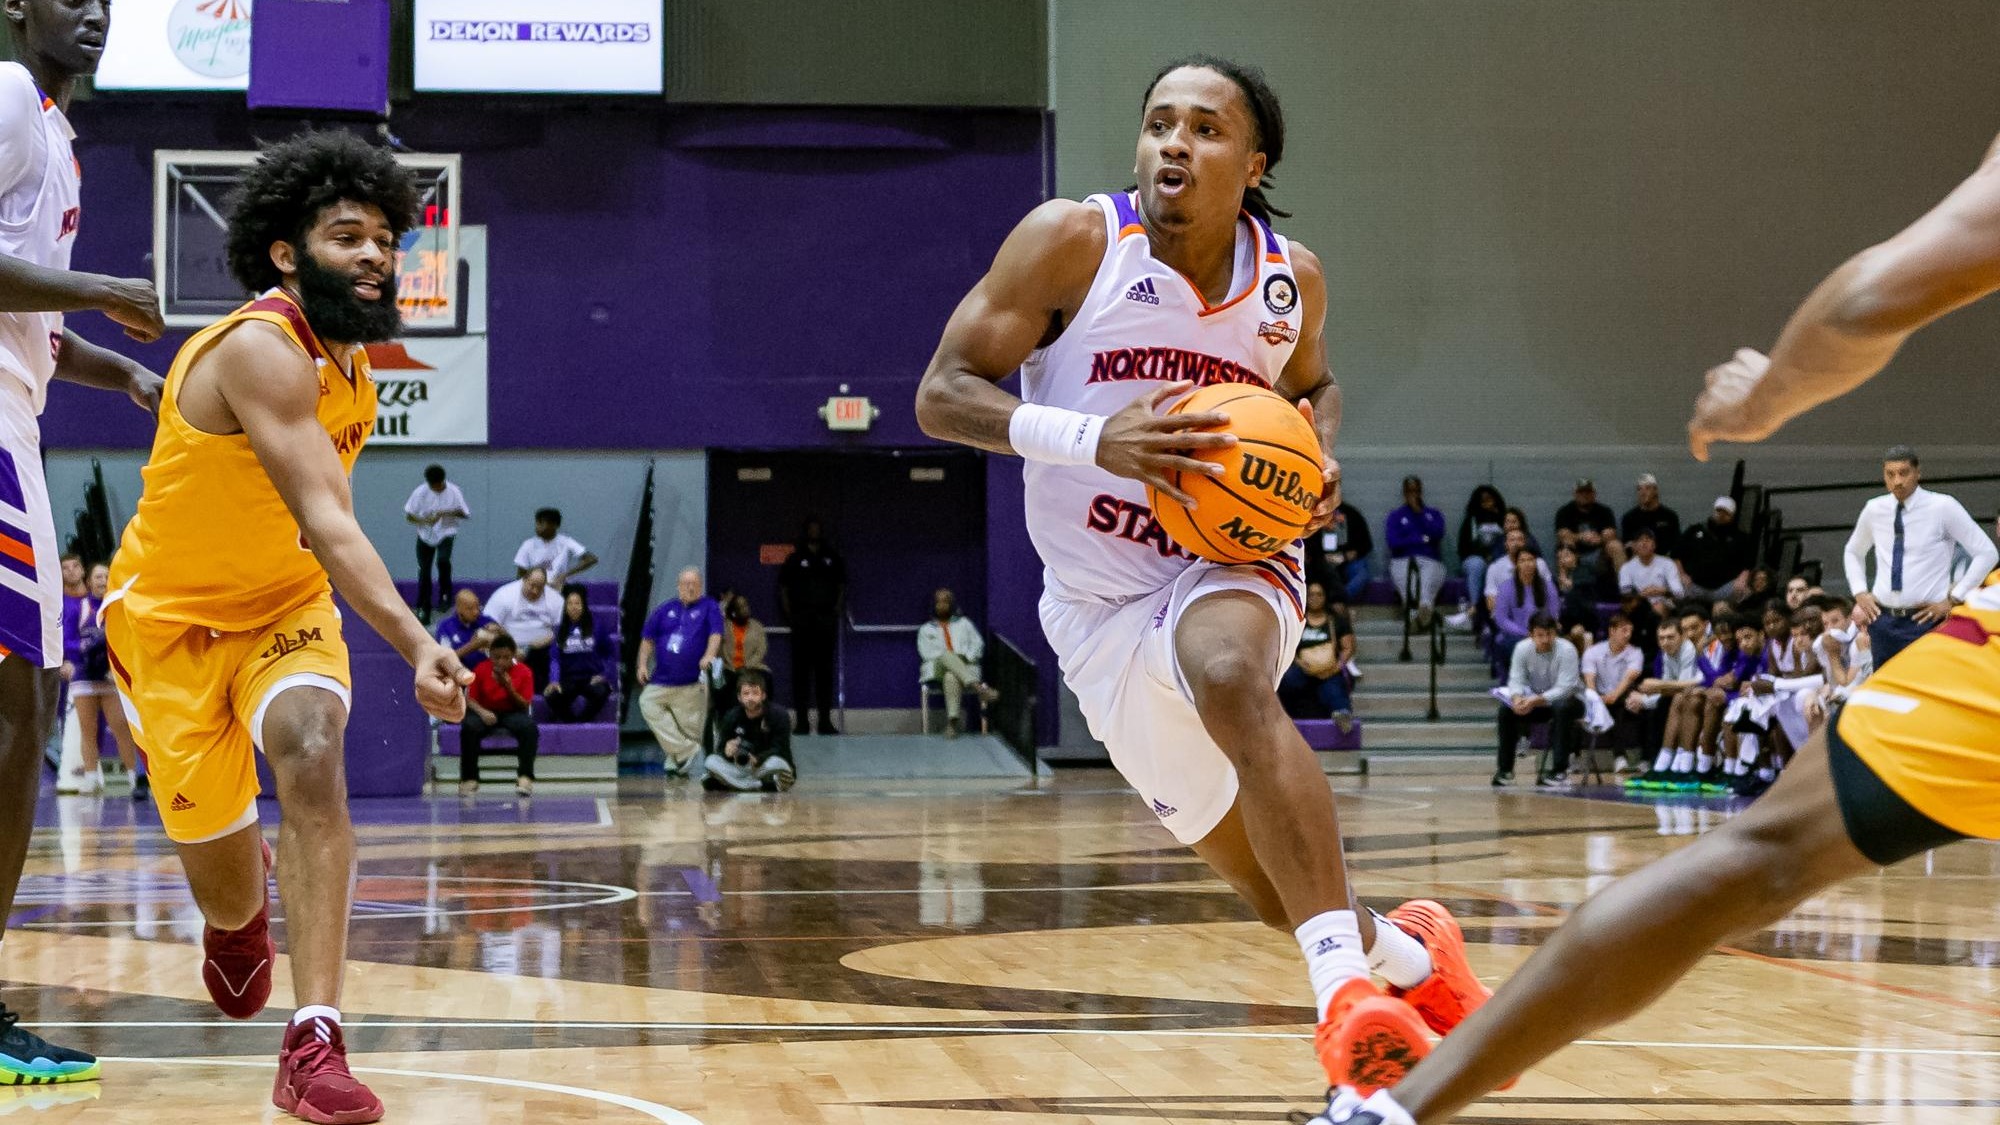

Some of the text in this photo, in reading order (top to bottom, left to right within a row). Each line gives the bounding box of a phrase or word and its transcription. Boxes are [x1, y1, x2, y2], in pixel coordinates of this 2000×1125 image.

[431, 21, 650, 43] DEMON REWARDS
[1126, 291, 1160, 305] adidas
[836, 399, 863, 420] EXIT
[1241, 453, 1314, 511] Wilso
